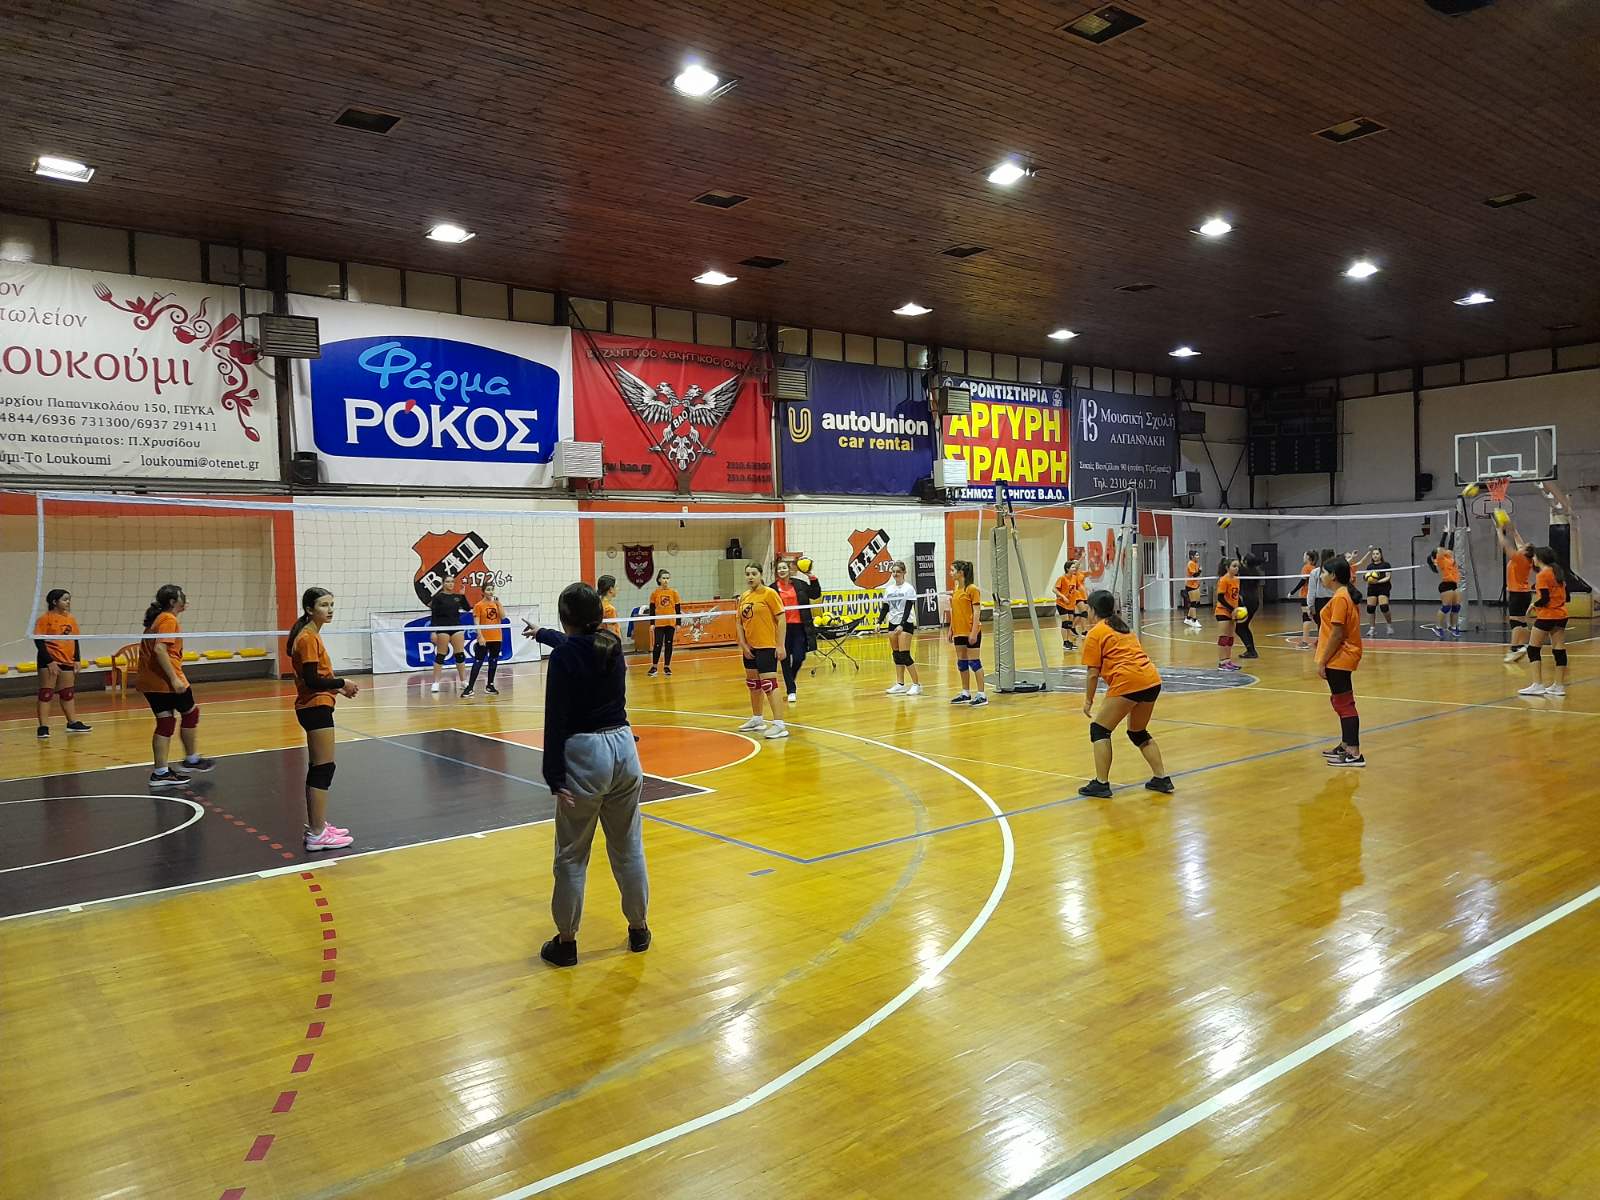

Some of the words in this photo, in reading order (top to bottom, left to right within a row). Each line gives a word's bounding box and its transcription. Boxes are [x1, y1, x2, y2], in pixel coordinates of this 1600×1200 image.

[0, 345, 194, 395] ουκούμι
[358, 341, 511, 403] Φάρμα
[47, 397, 140, 412] Παπανικολάου
[144, 403, 170, 415] 150,
[174, 404, 216, 416] ΠΕΥΚΑ
[172, 420, 217, 432] 291411
[821, 410, 929, 436] autoUnion
[1100, 407, 1144, 429] Μουσική
[1145, 411, 1176, 431] Σχολή
[128, 436, 202, 449] Π.Χρυσίδου
[838, 435, 865, 449] car
[869, 436, 914, 451] rental
[47, 452, 112, 466] Loukoumi
[140, 454, 260, 472] loukoumi@otenet.gr
[1000, 488, 1037, 501] ΟΡΗΓΟΣ
